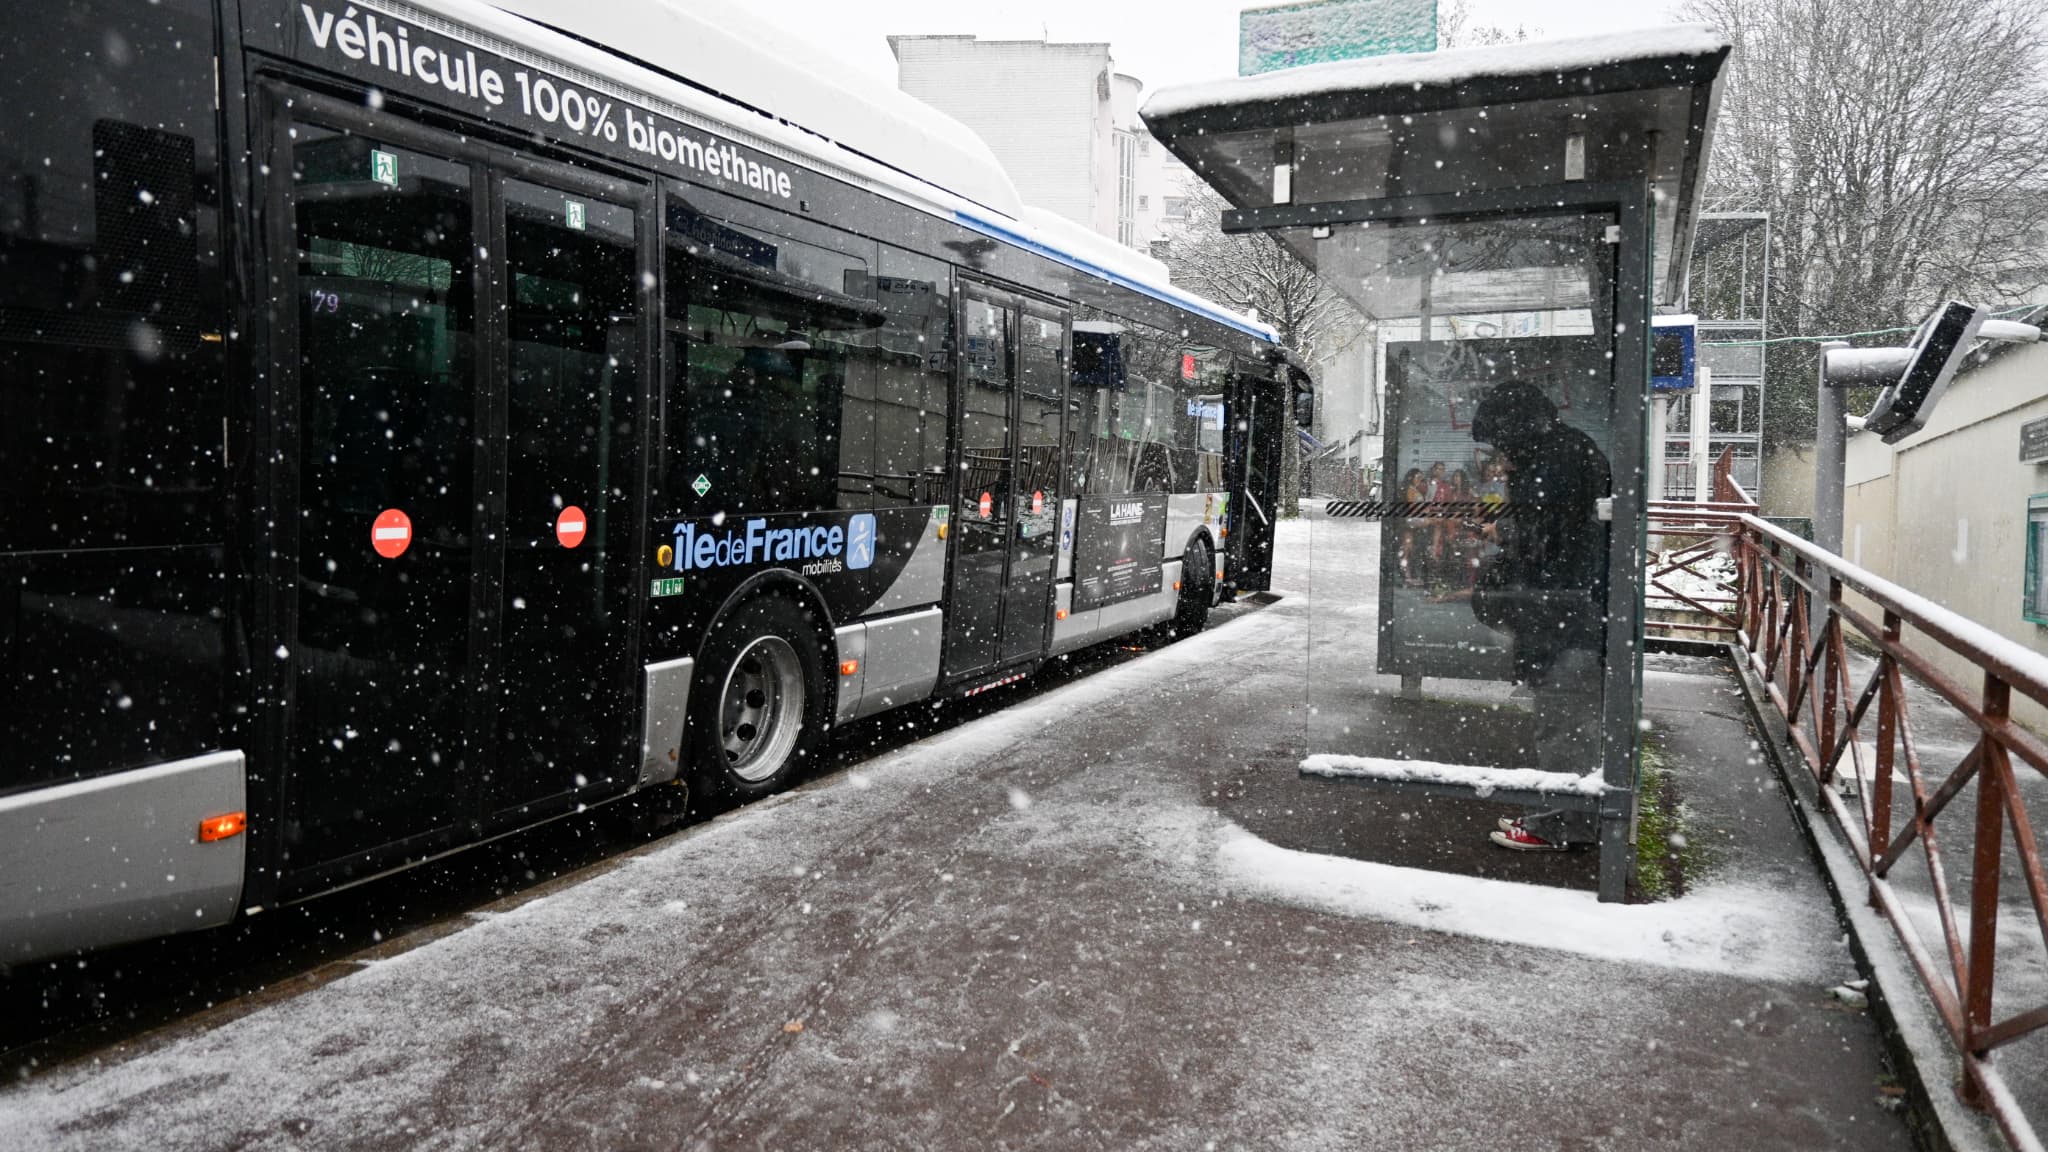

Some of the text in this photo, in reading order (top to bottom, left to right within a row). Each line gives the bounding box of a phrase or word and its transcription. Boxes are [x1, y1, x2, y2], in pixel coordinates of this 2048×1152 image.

[301, 3, 792, 199] véhicule 100% biométhane
[802, 557, 842, 577] mobilités
